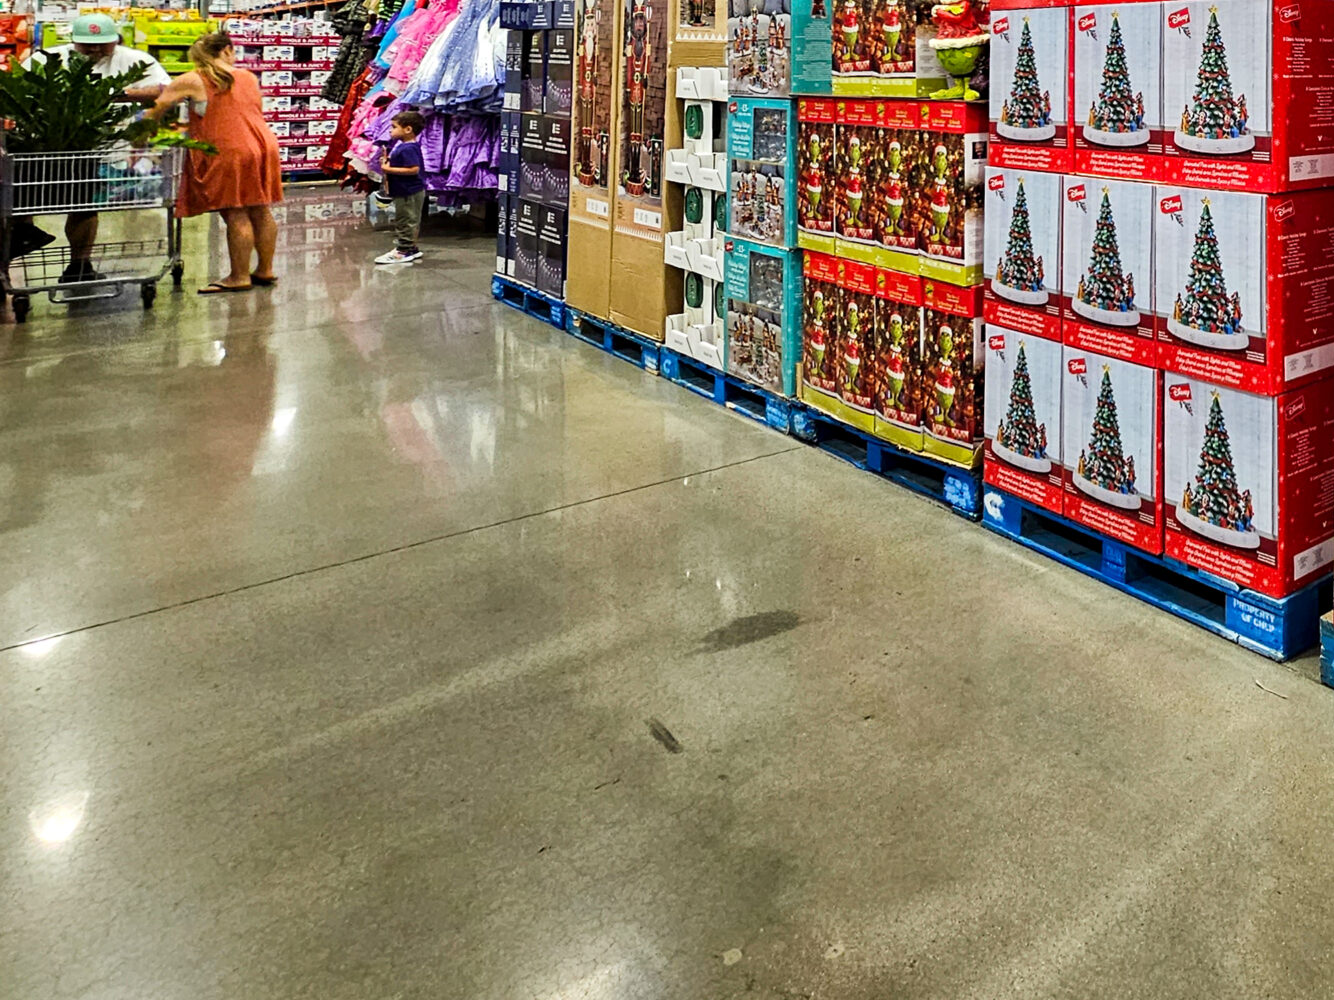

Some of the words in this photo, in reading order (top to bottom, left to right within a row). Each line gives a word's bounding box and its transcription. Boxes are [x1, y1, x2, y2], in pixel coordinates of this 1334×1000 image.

[1080, 17, 1096, 28] Disney
[1170, 13, 1189, 25] Disney
[1069, 189, 1086, 200] Disney
[1162, 200, 1182, 211] Disney
[1070, 362, 1086, 372] Disney
[1171, 387, 1190, 398] Disney
